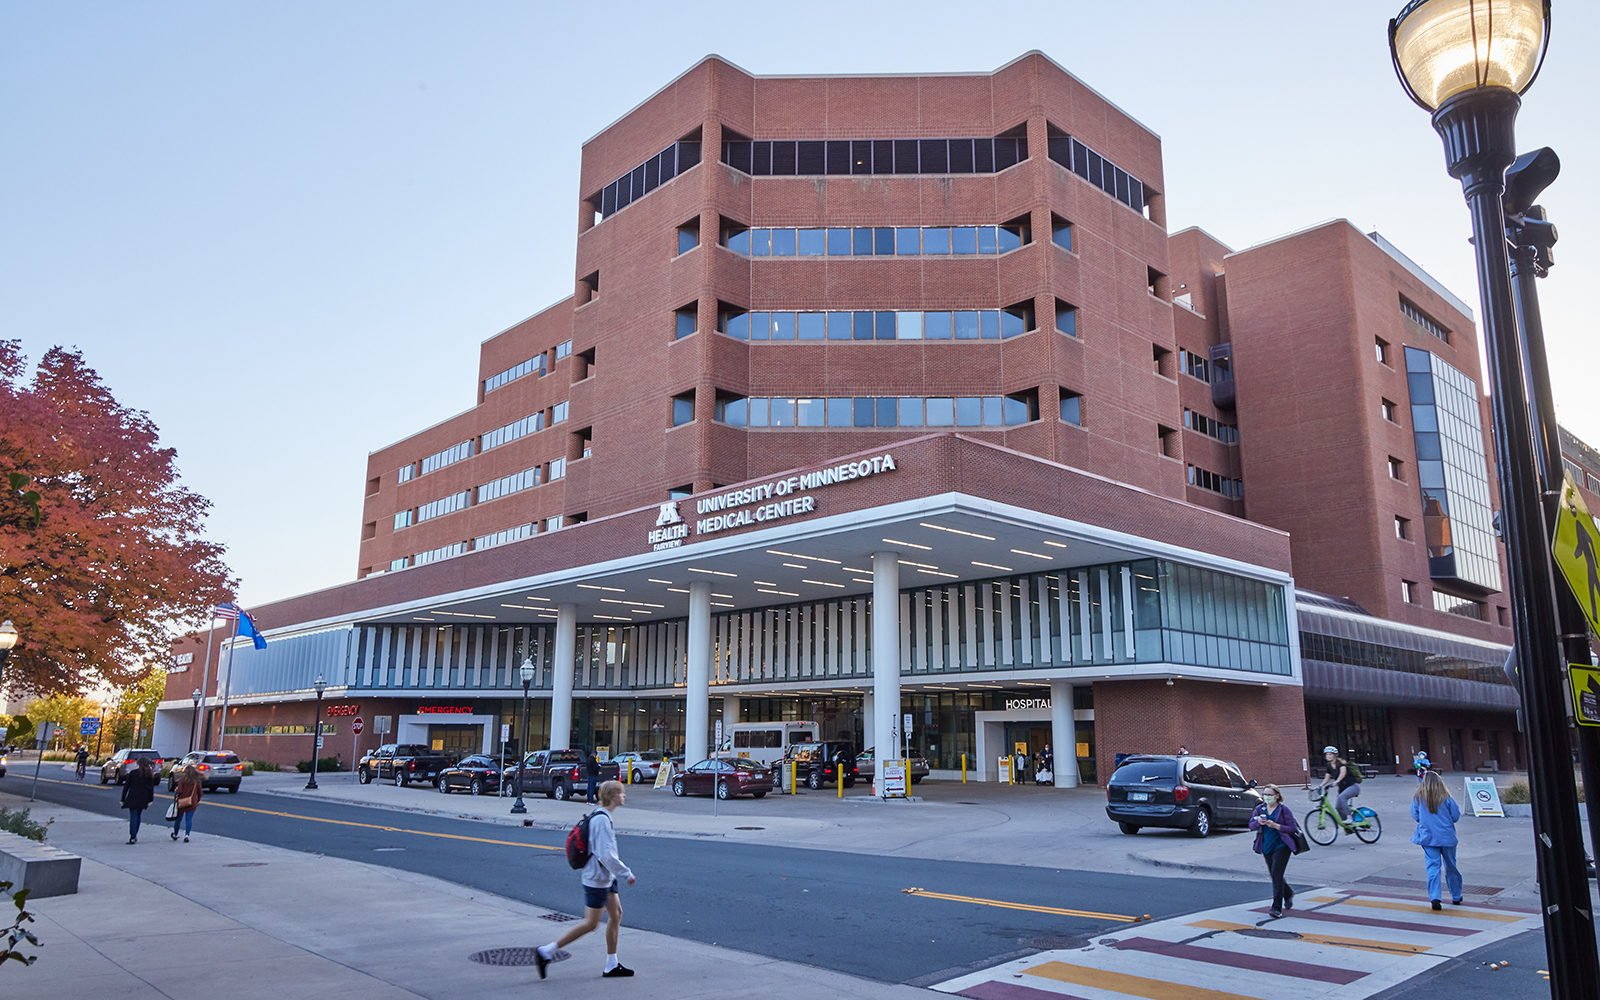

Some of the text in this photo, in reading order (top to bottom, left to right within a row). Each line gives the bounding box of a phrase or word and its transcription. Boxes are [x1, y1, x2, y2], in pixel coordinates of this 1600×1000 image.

[696, 454, 896, 514] UNIVERSITY OF MINNESOTA
[696, 495, 815, 535] MEDICAL CENTER
[648, 523, 688, 544] HEALTH
[653, 539, 682, 551] FAIRVIEW
[327, 704, 359, 716] EMERGENCY
[419, 706, 474, 714] EMERGENCY
[1005, 699, 1052, 709] HOSPITAL
